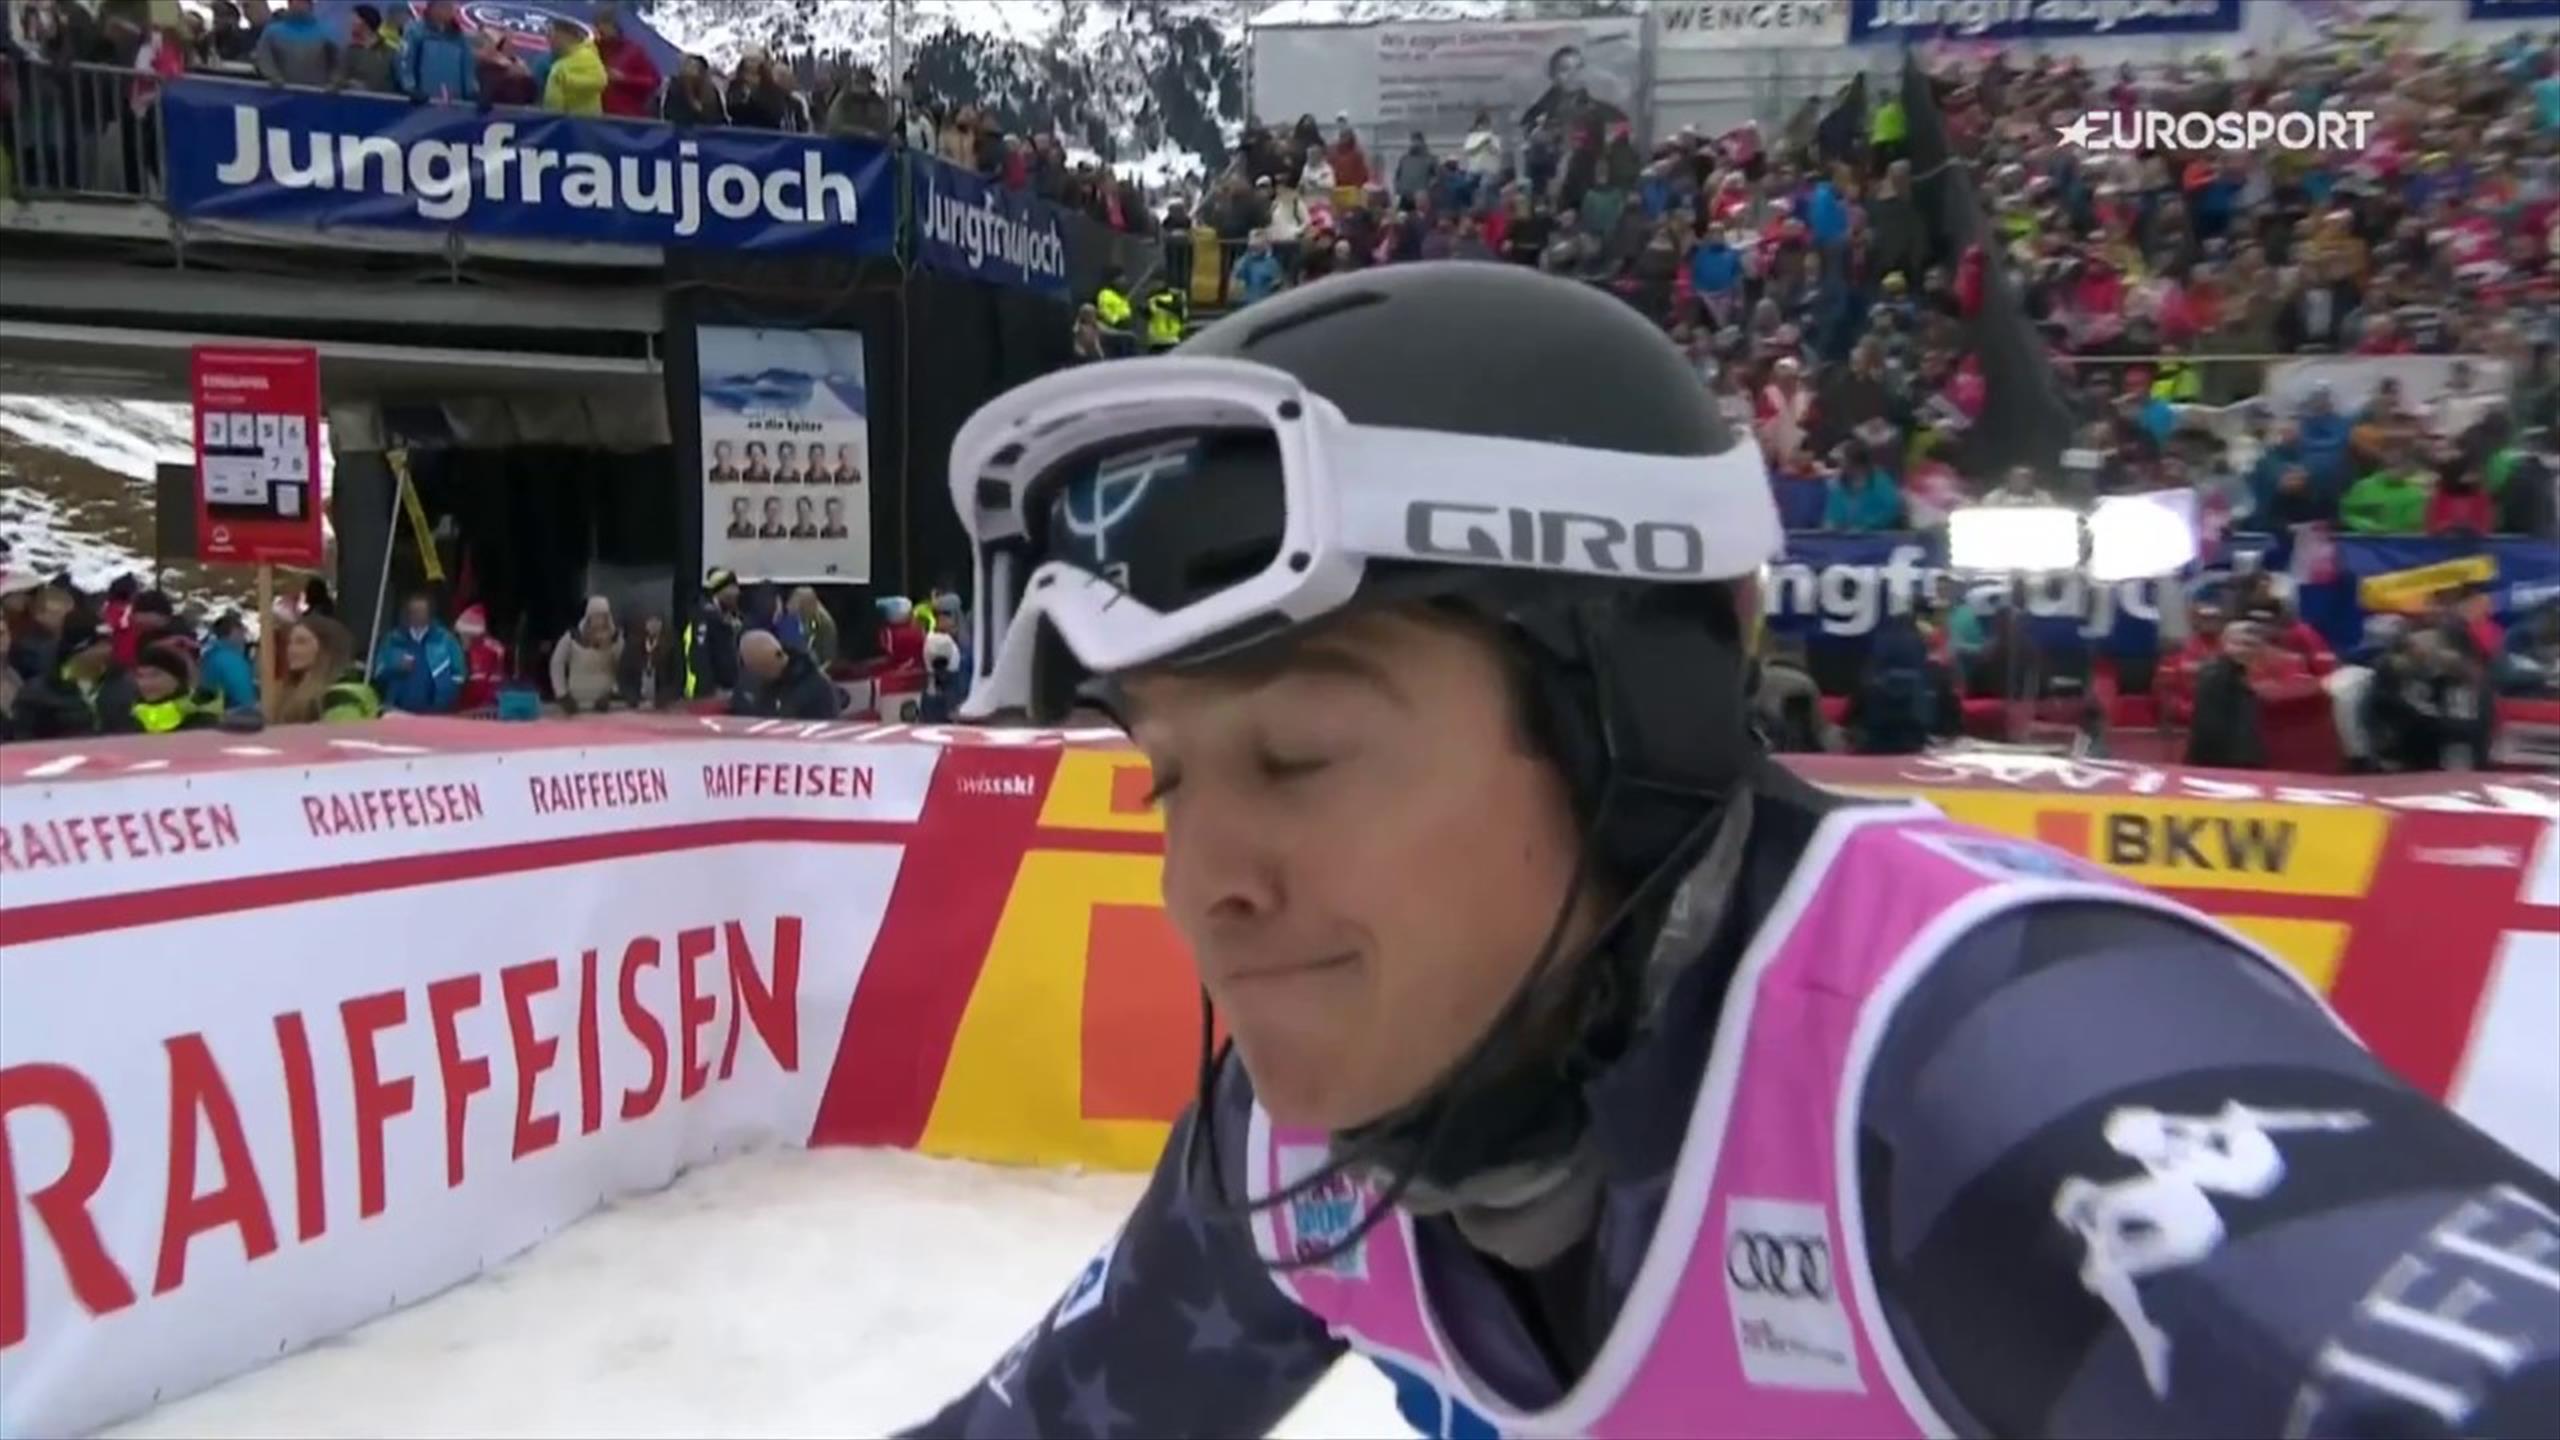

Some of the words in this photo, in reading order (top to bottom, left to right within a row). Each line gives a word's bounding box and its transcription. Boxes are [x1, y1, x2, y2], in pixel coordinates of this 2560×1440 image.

[217, 106, 857, 236] Jungfraujoch
[924, 176, 1065, 283] Jungfraujoch
[1406, 500, 1704, 574] GIRO
[301, 783, 484, 839] RAIFFEISEN
[530, 766, 669, 815] RAIFFEISEN
[702, 764, 874, 799] RAIFFEISEN
[0, 803, 240, 871] RAIFFEISEN
[2106, 812, 2297, 875] BKW
[0, 916, 803, 1351] RAIFFEISEN
